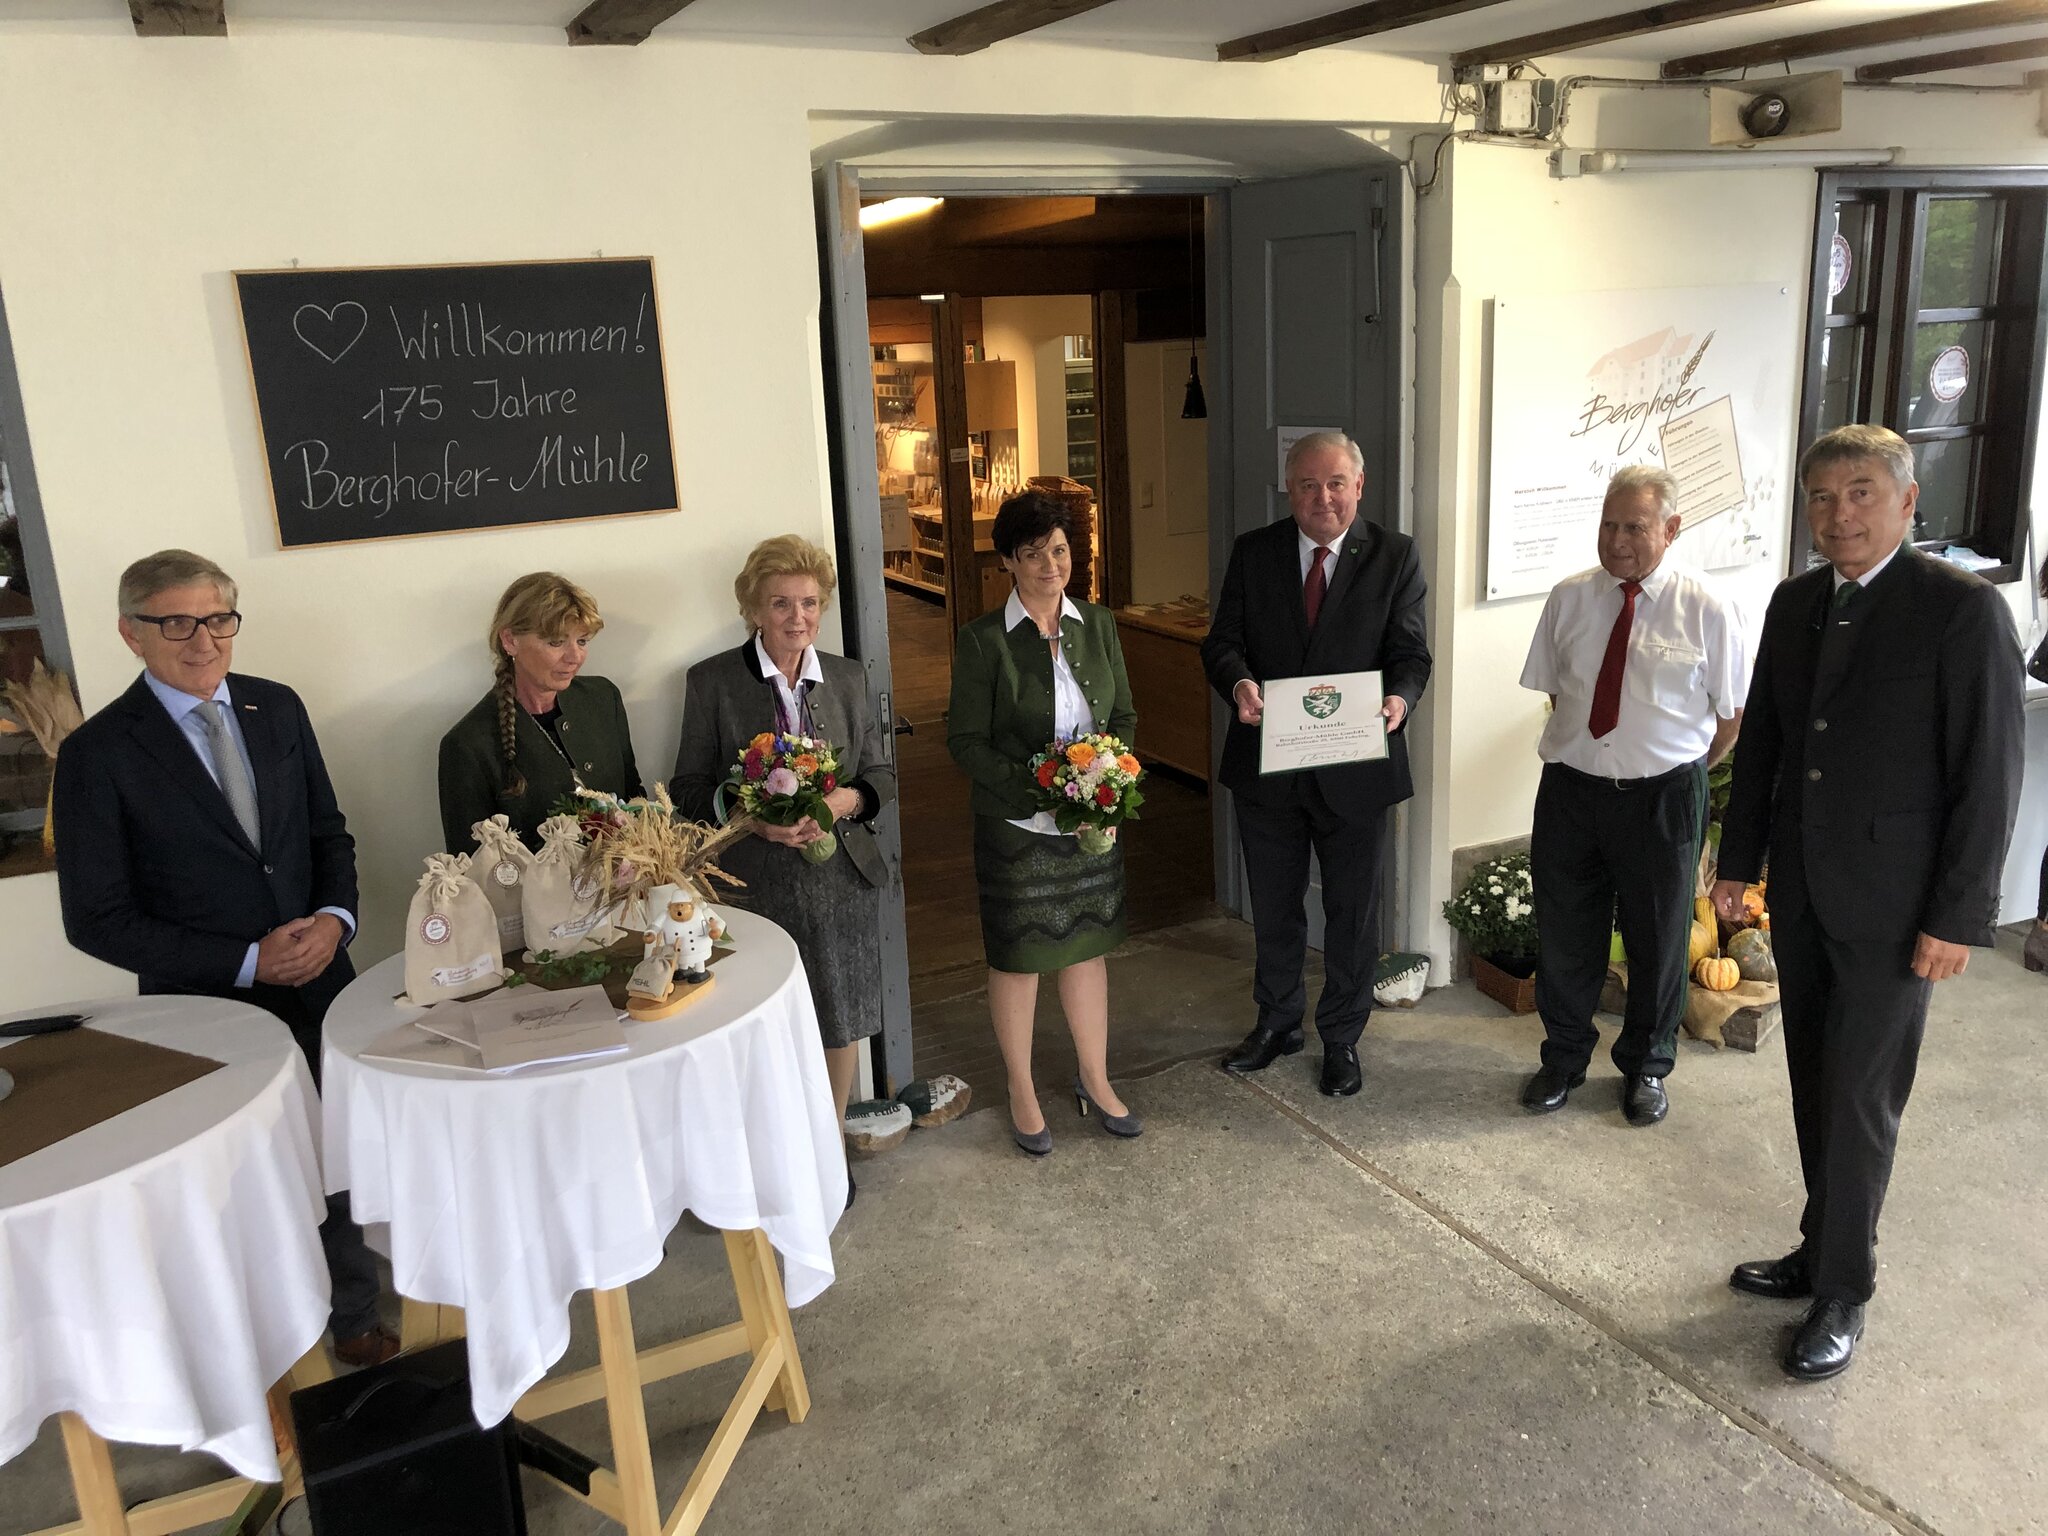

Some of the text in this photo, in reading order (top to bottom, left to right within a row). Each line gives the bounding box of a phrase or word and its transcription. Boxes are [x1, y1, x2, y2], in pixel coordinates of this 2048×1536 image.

[389, 292, 647, 360] Willkommen!
[362, 376, 577, 428] 175 Jahre
[1570, 383, 1706, 456] Berghofer
